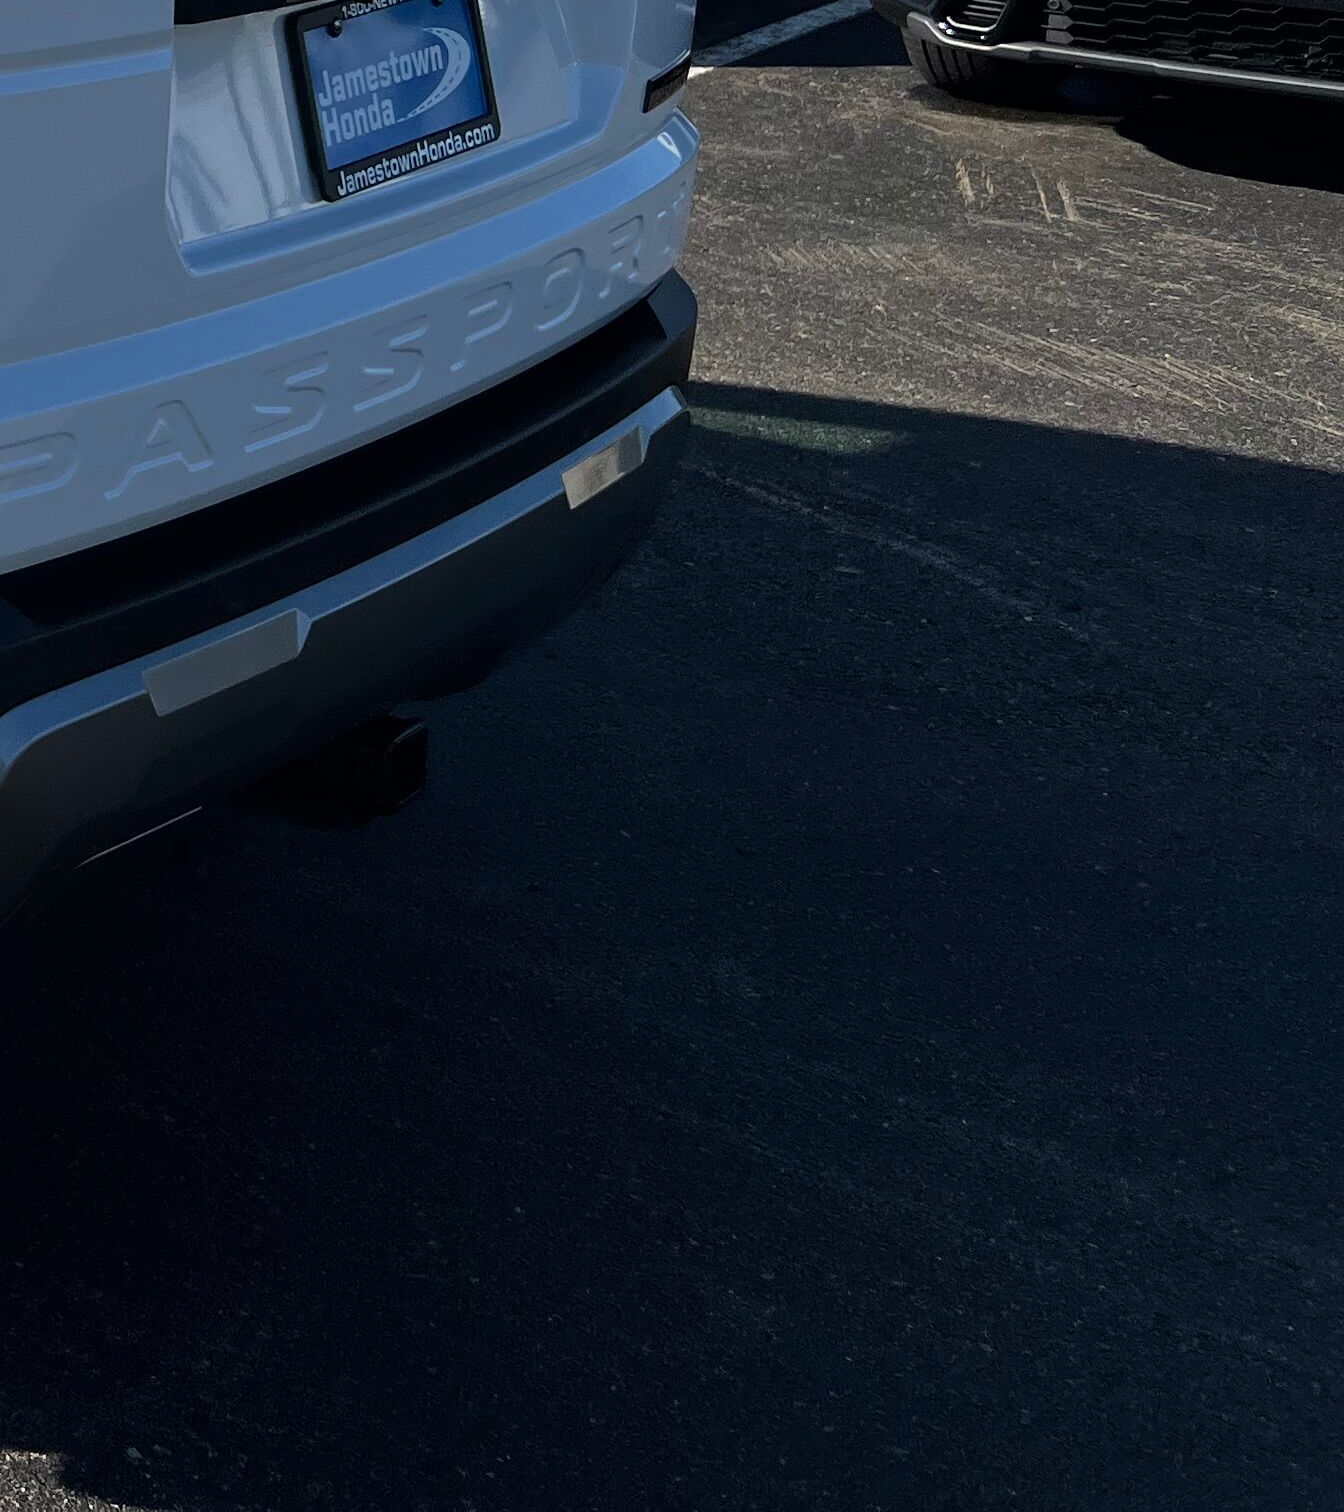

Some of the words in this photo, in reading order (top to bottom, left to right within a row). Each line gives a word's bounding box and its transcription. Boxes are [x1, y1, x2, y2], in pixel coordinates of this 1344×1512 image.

[319, 43, 444, 107] Jamestown
[322, 95, 396, 148] Honda
[337, 121, 496, 197] JamestownHonda.com
